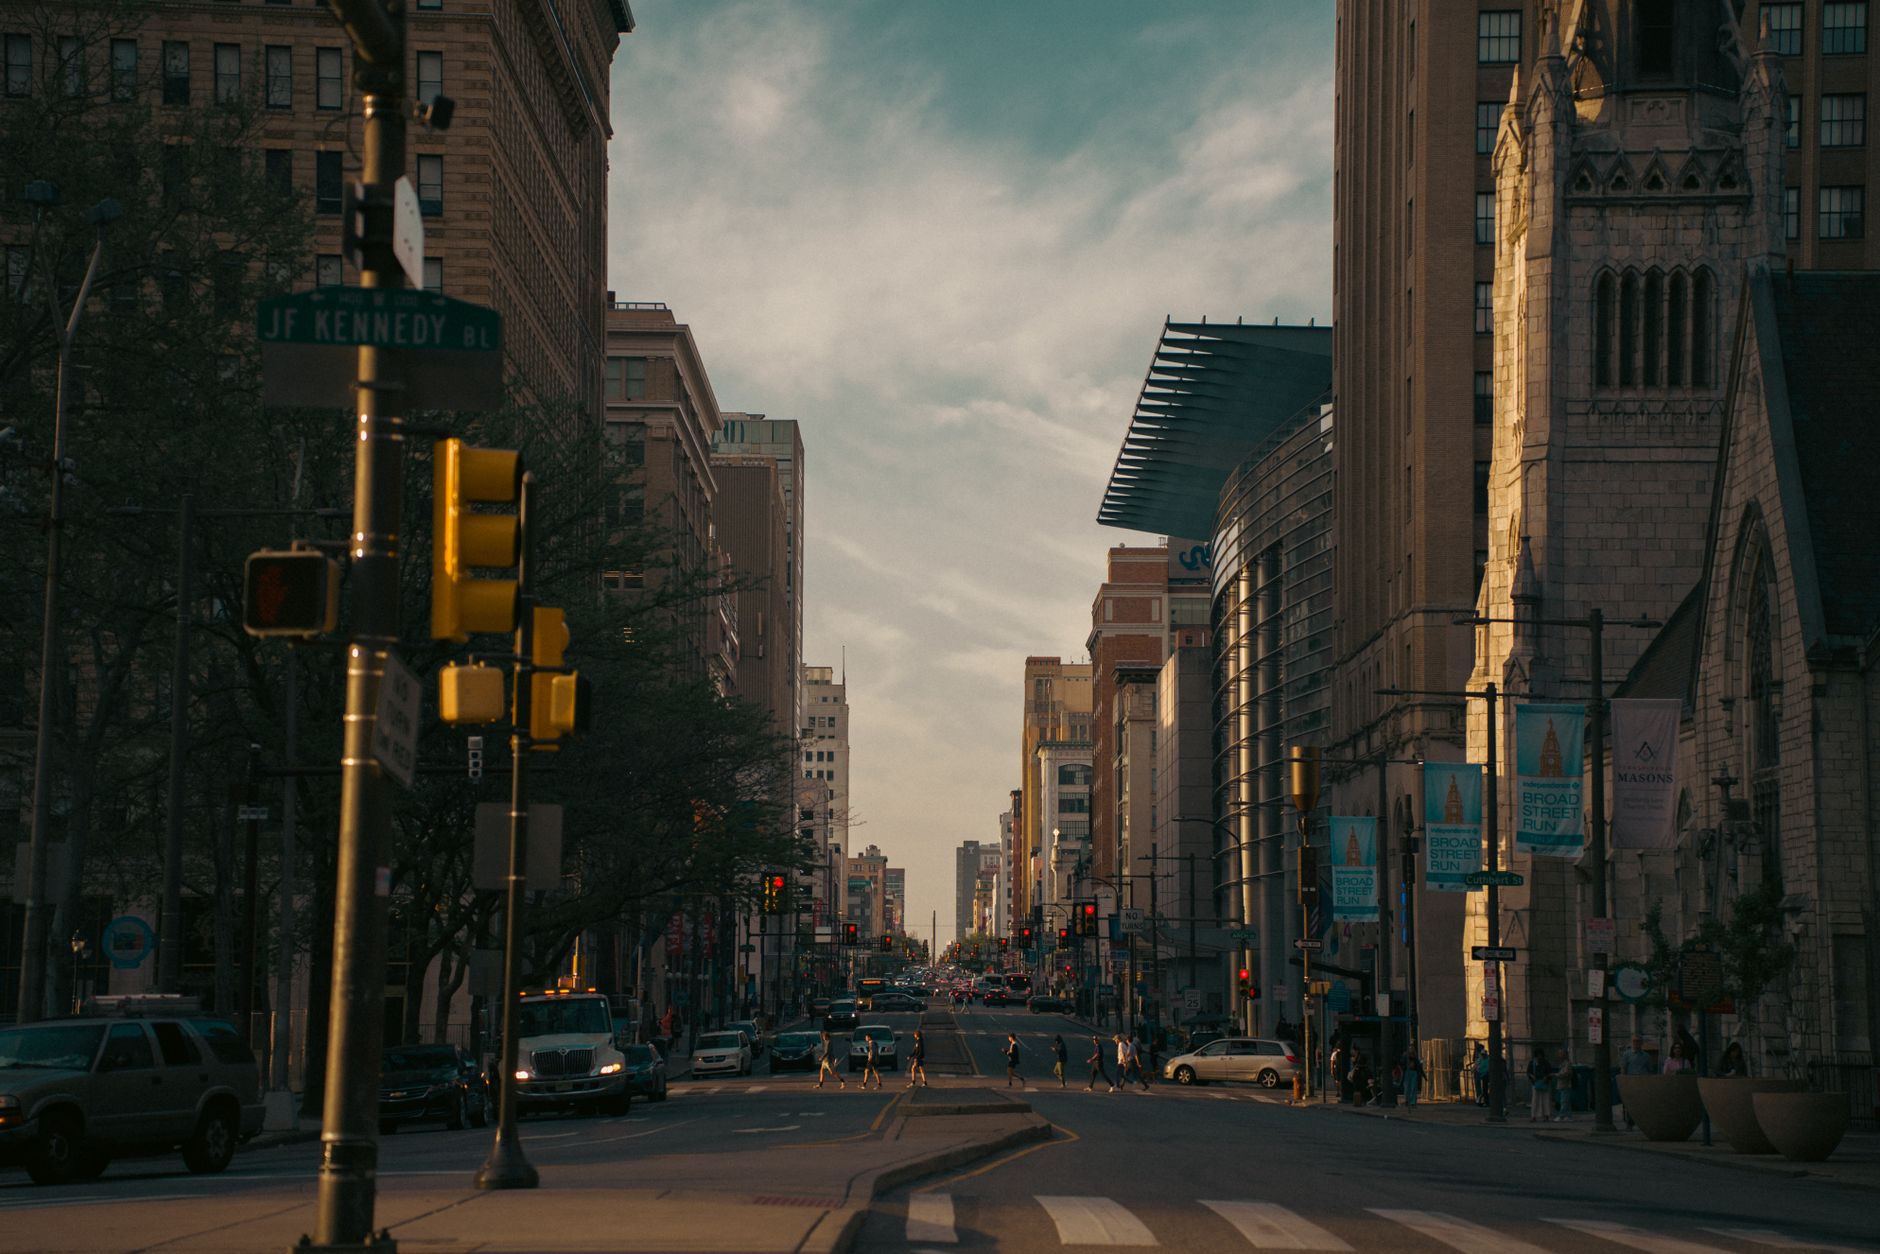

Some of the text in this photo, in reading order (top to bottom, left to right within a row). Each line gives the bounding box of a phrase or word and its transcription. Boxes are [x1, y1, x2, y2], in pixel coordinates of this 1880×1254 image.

[264, 307, 490, 348] JF KENNEDY BL
[1617, 772, 1674, 784] MASONS
[1522, 792, 1580, 805] BROAD
[1522, 805, 1579, 819] STREET
[1523, 818, 1557, 832] RUN
[1430, 837, 1479, 848] BROAD
[1430, 849, 1480, 860] STREET
[1430, 861, 1460, 871] RUN
[1335, 877, 1373, 886] BROAD
[1466, 875, 1509, 885] Cuthbert
[1335, 887, 1373, 896] STREET
[1336, 896, 1360, 905] RUN
[1125, 912, 1138, 920] NO
[1187, 999, 1199, 1008] 25
